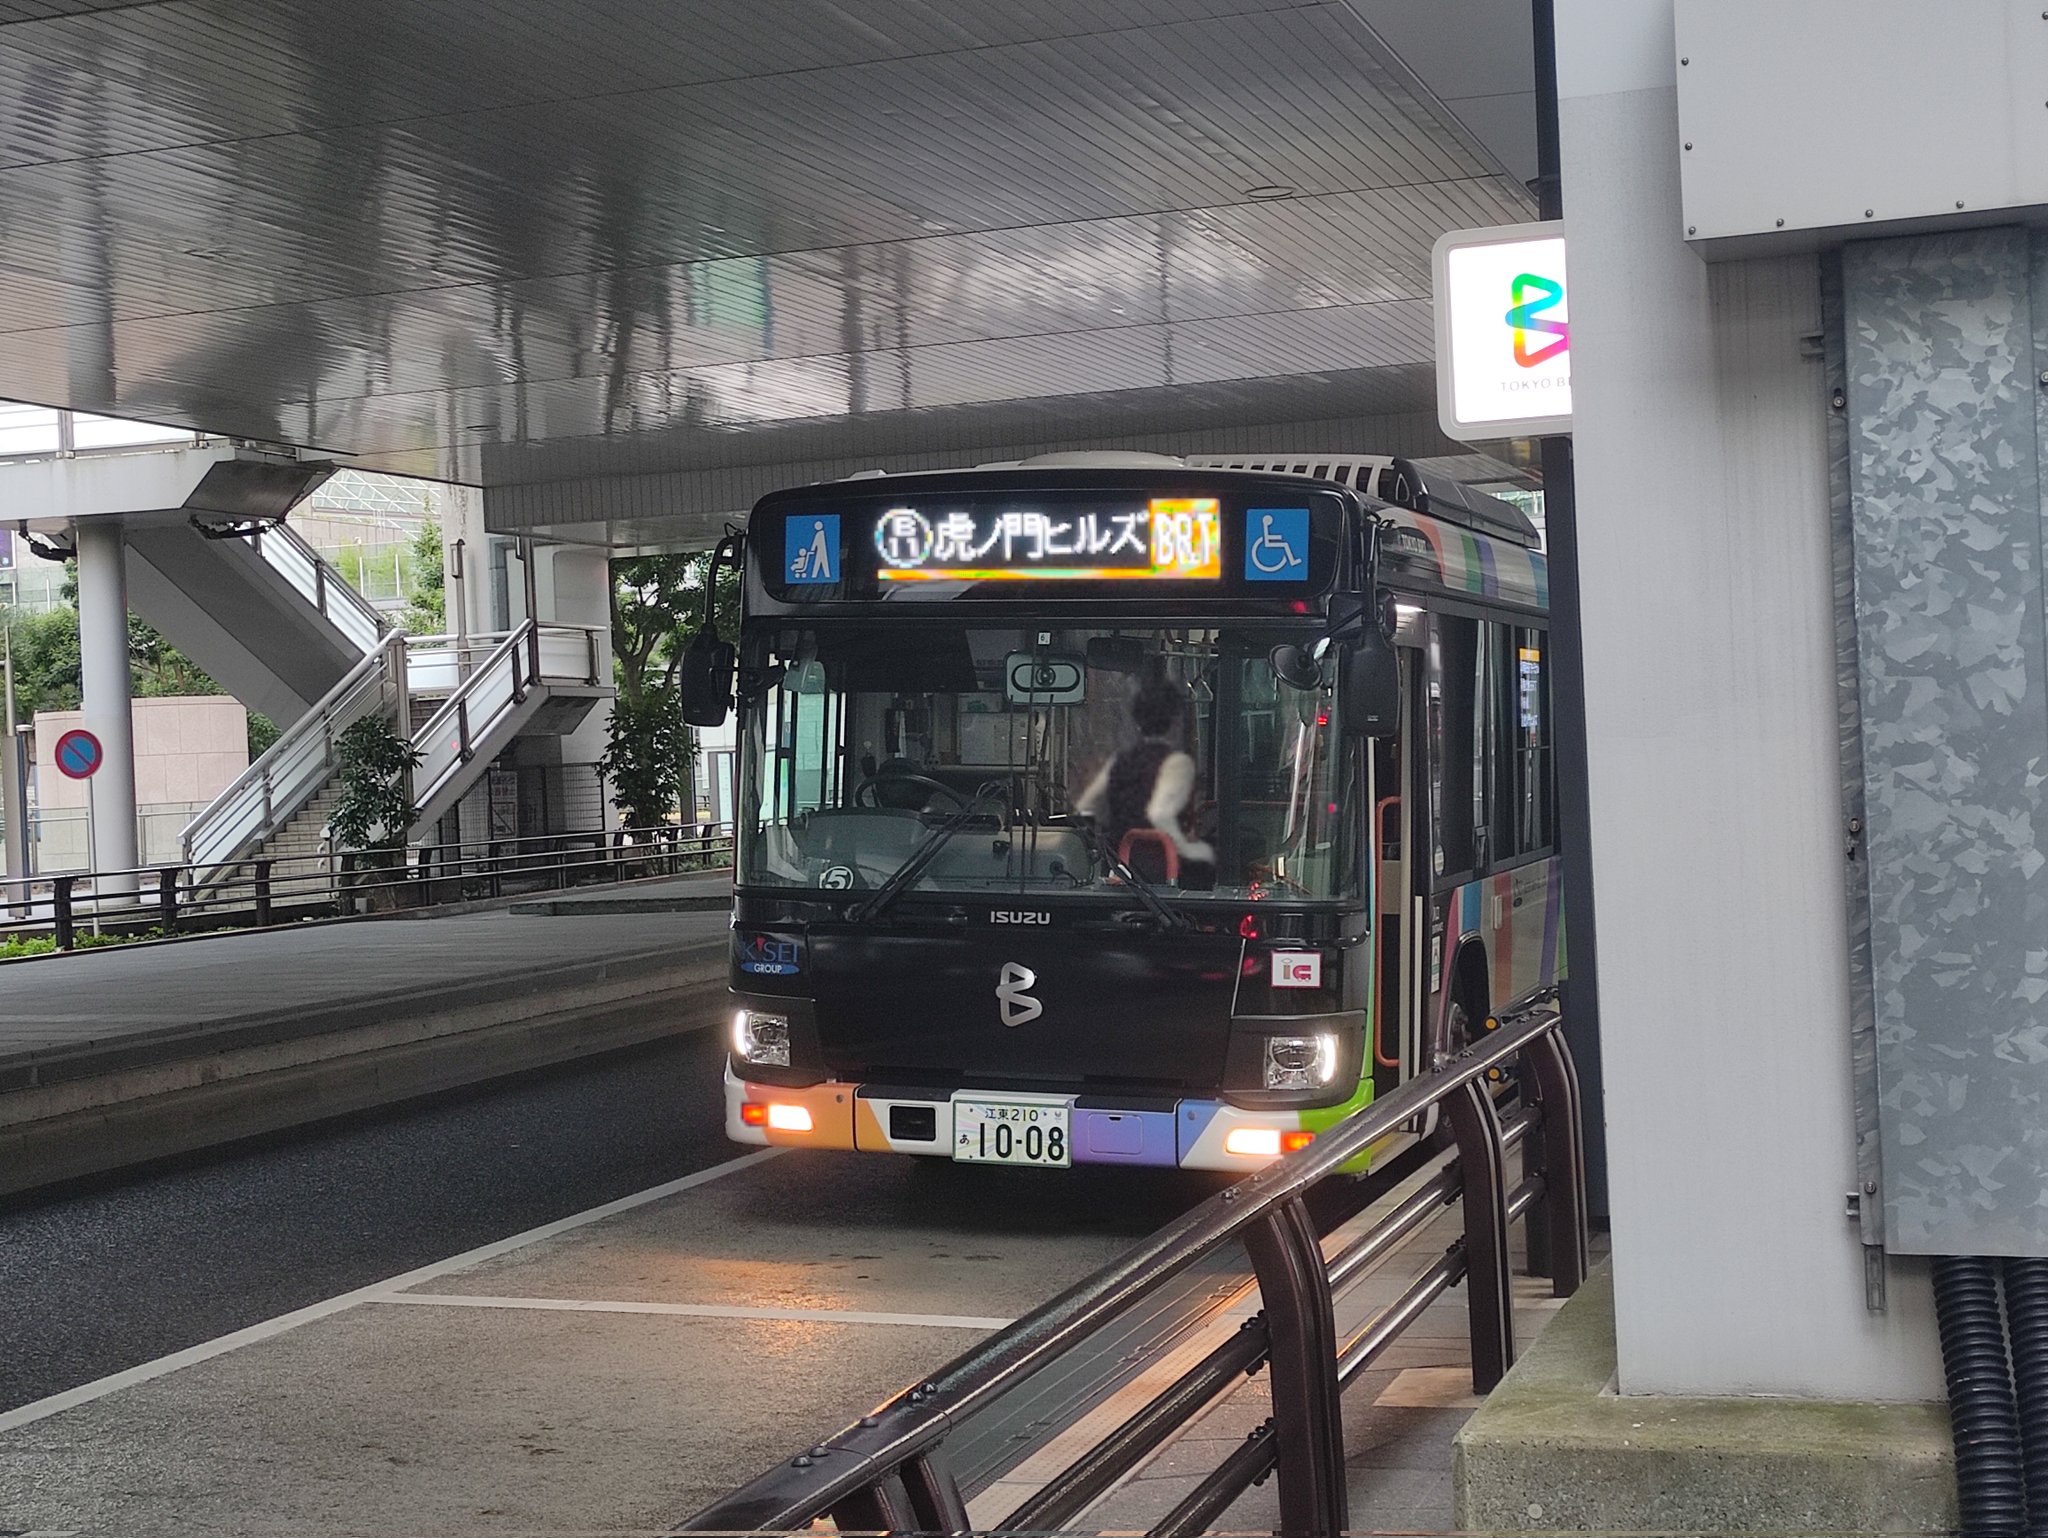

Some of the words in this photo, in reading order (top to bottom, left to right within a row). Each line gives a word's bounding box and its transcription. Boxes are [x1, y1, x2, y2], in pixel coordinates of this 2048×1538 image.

[1501, 378, 1551, 392] TOKYO
[933, 510, 1150, 561] 虎ノ門ヒルズ
[1152, 512, 1215, 566] BRT
[825, 869, 848, 889] 5
[990, 910, 1050, 924] ISUZU
[753, 963, 783, 974] GROUP
[979, 1122, 1065, 1161] 10-08
